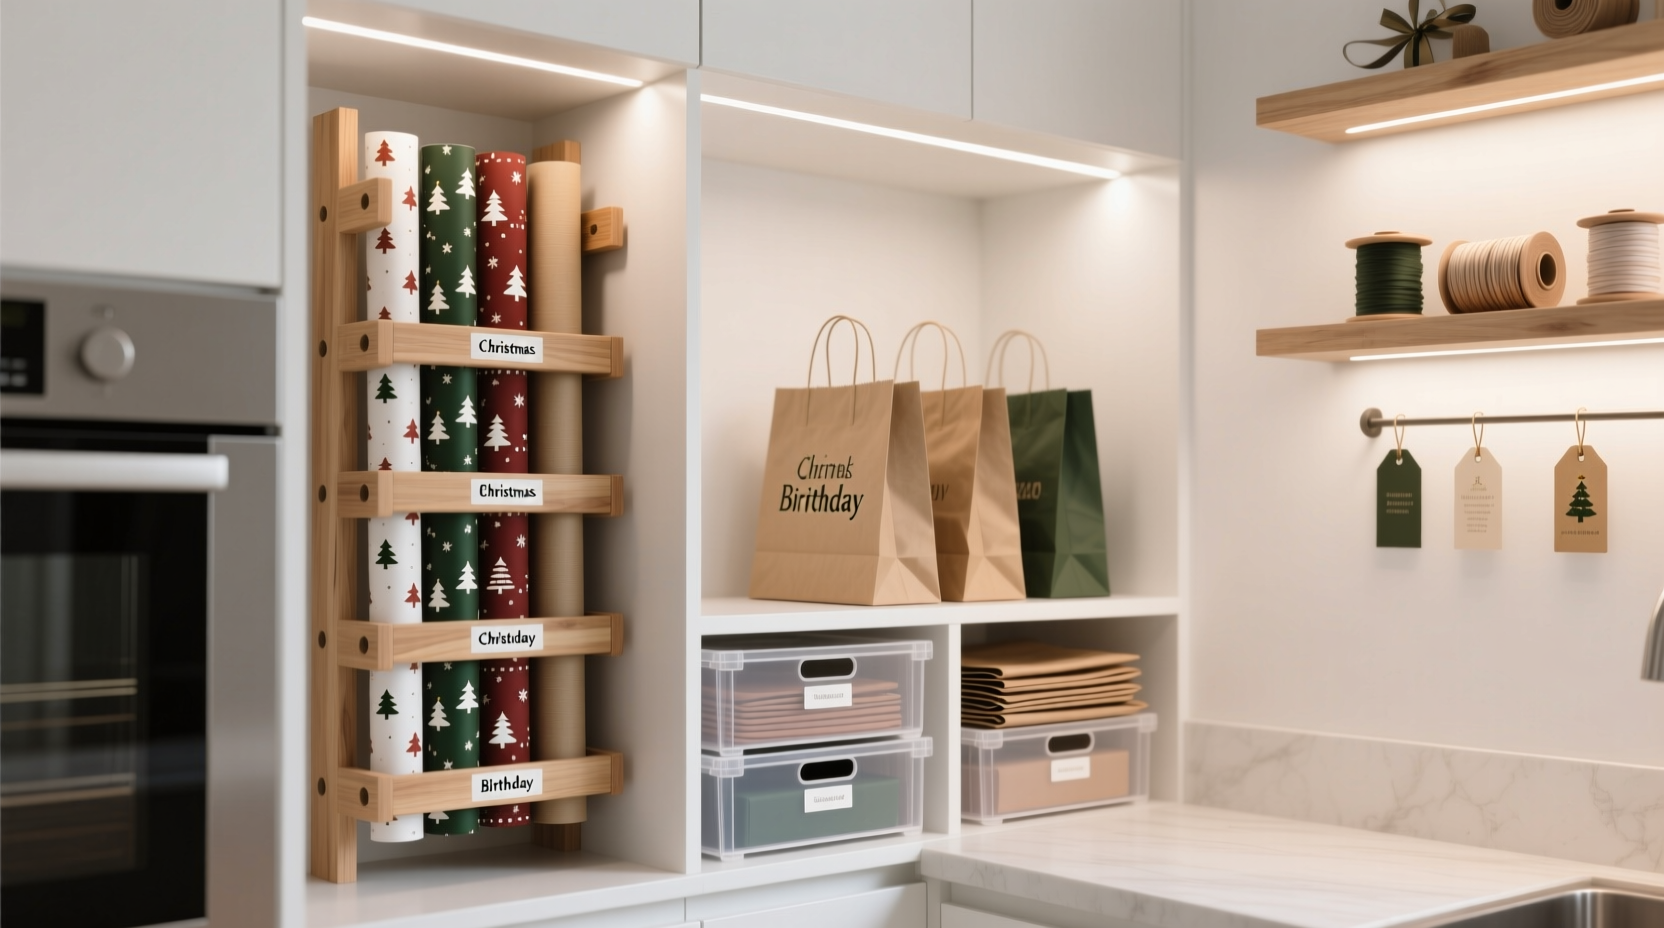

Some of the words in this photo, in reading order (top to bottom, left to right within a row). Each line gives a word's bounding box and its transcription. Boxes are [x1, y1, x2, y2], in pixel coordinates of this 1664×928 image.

[479, 339, 536, 355] Christmas
[479, 483, 536, 498] Christmas
[481, 774, 534, 793] Birthday
